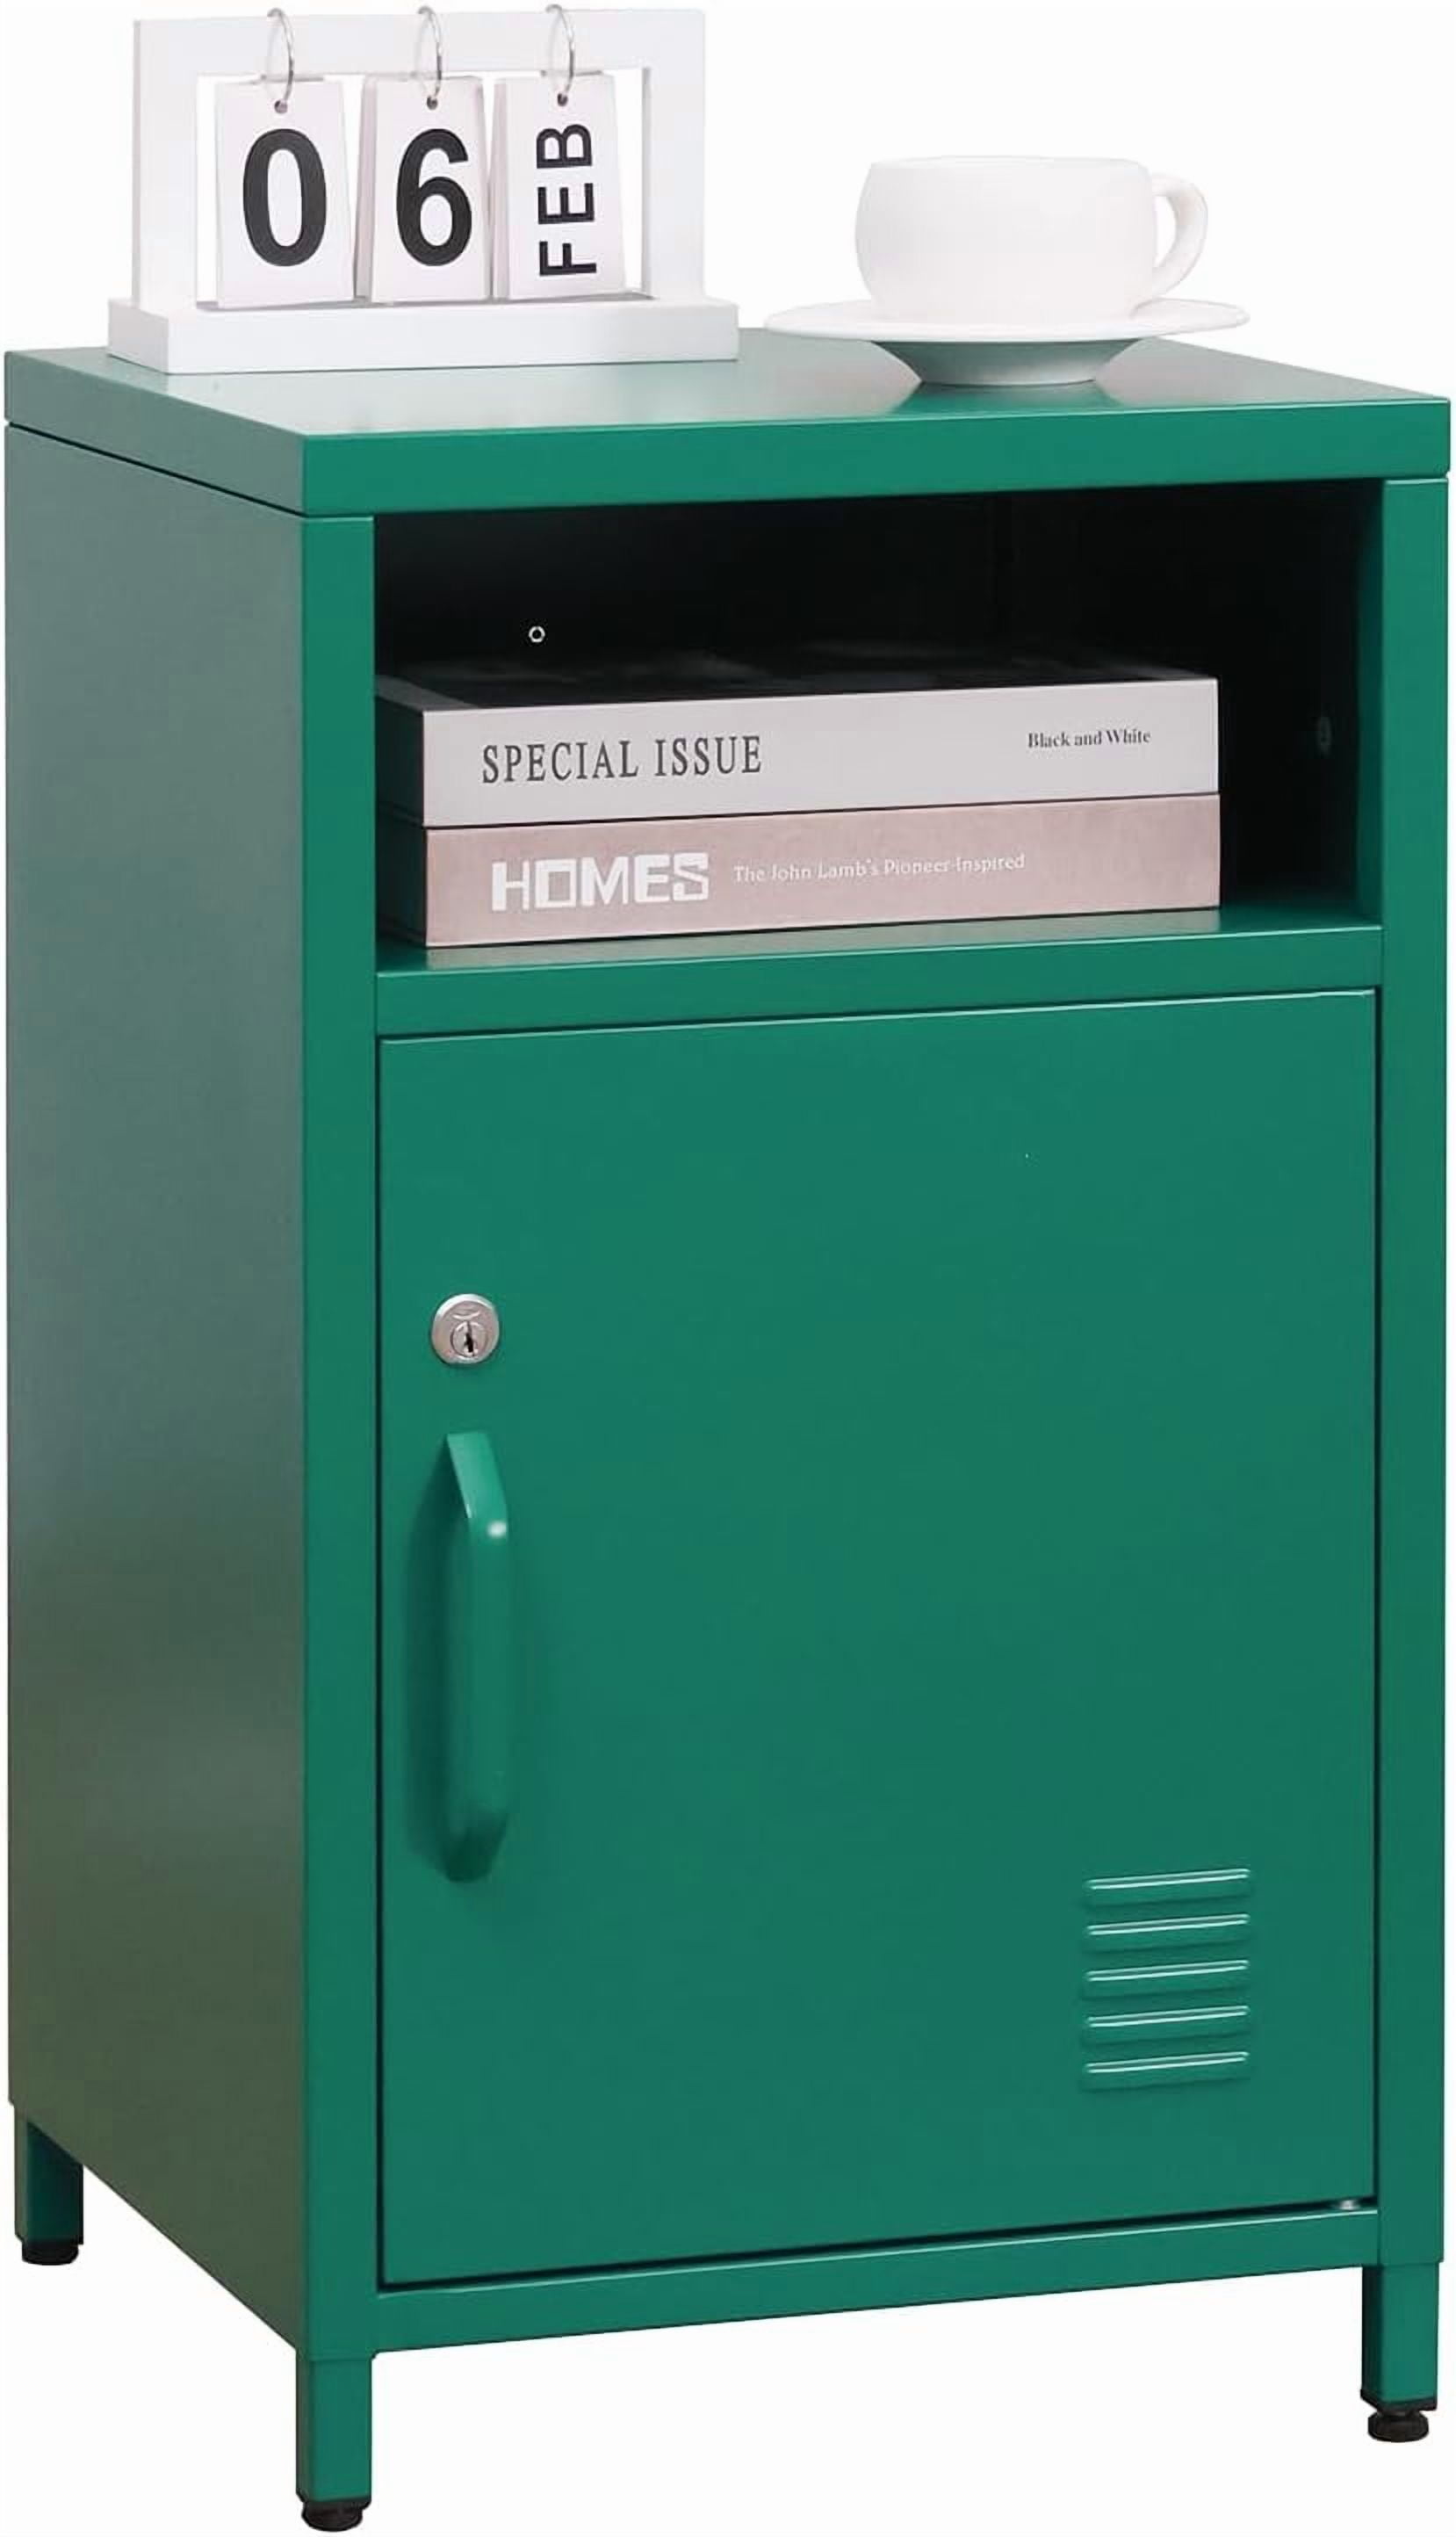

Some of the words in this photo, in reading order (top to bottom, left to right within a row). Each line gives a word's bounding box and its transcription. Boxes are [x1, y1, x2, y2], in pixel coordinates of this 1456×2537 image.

[243, 128, 327, 266] 0
[396, 128, 472, 266] 6
[537, 124, 597, 277] FEB
[482, 741, 638, 784] SPECIAL
[654, 735, 761, 776] ISSUE
[1027, 731, 1070, 748] Black
[1074, 730, 1102, 746] and
[1106, 728, 1151, 744] White
[491, 851, 710, 911] HOMES
[733, 865, 764, 883] The
[771, 864, 811, 881] John
[818, 858, 879, 879] Lamb's
